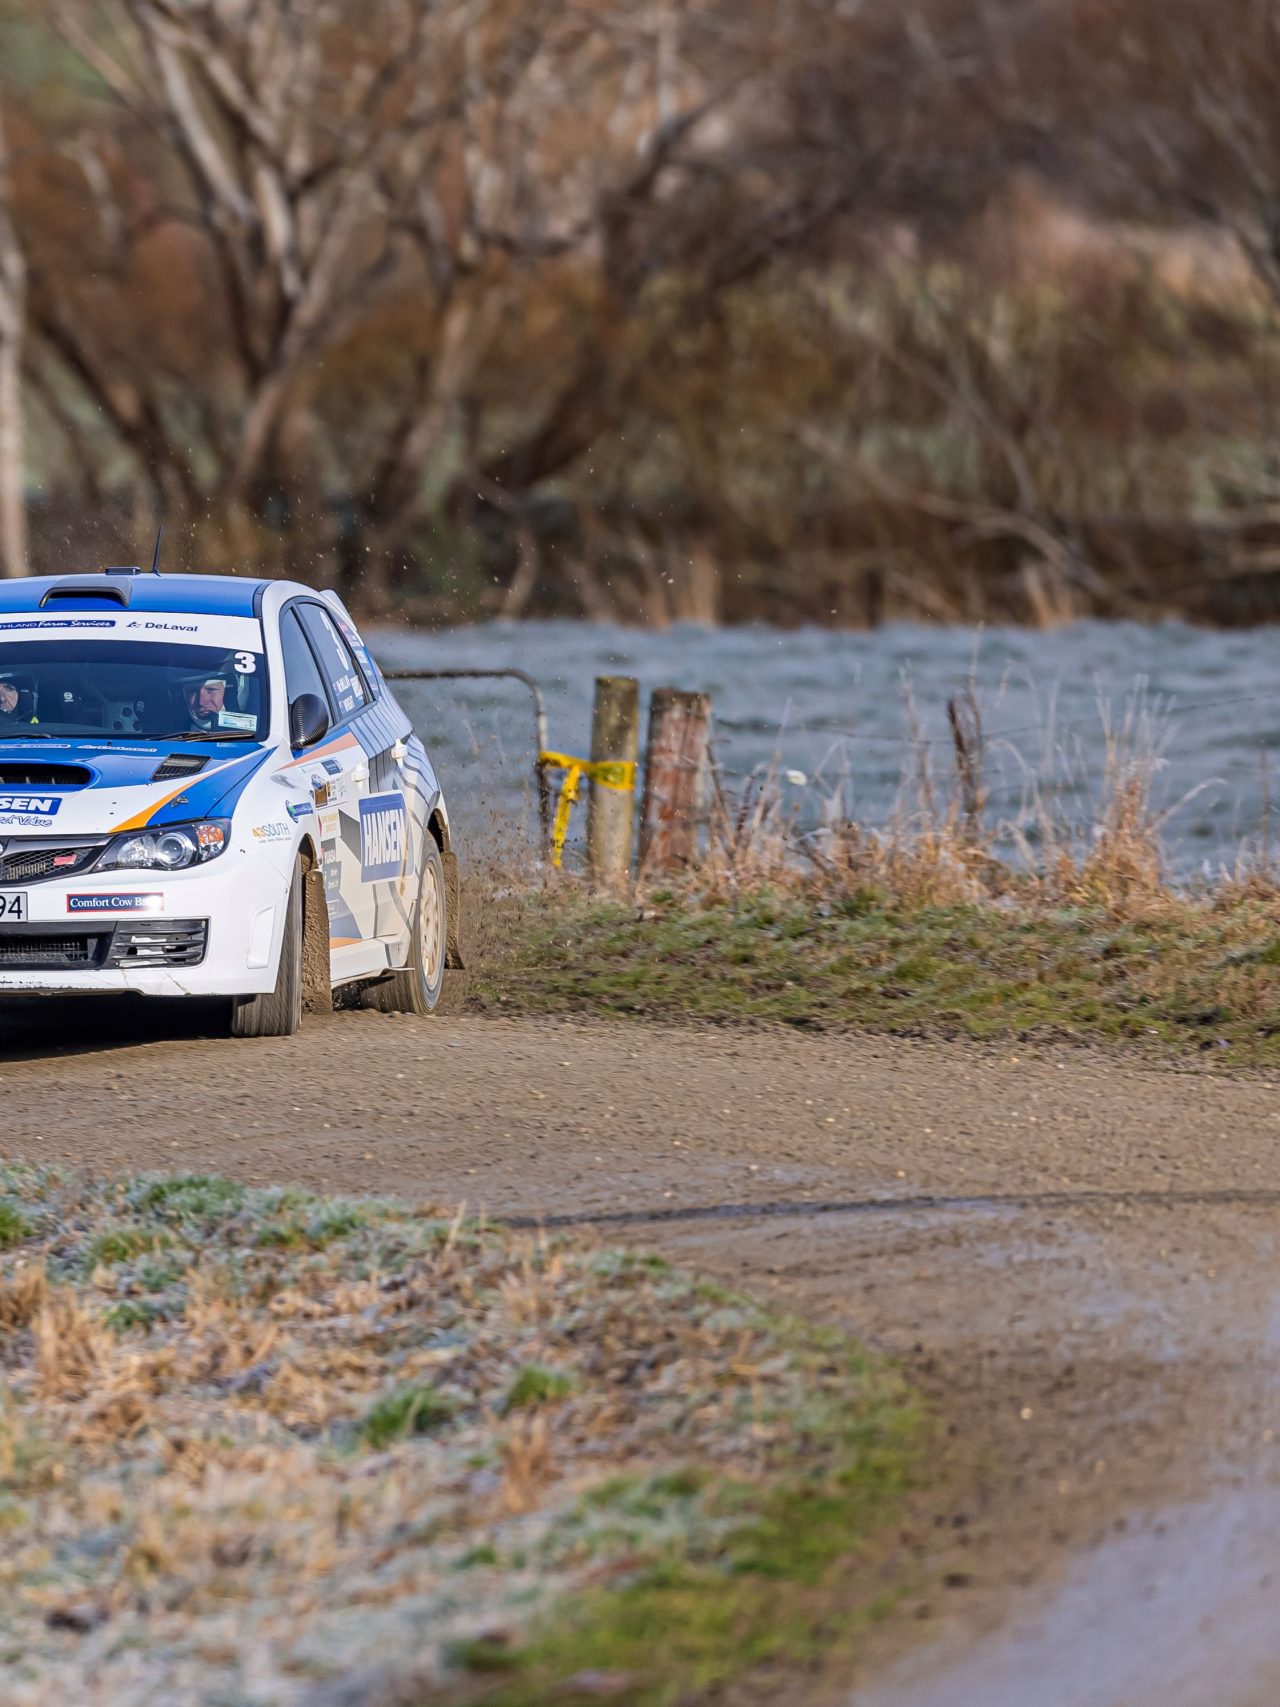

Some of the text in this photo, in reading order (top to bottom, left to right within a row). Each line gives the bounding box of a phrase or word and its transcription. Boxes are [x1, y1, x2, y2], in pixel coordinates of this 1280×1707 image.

[145, 622, 198, 632] DeLaval
[234, 651, 257, 674] 3
[17, 815, 53, 827] Value
[362, 808, 405, 867] HANSEN
[70, 898, 109, 908] Comfort
[111, 897, 133, 907] Cow
